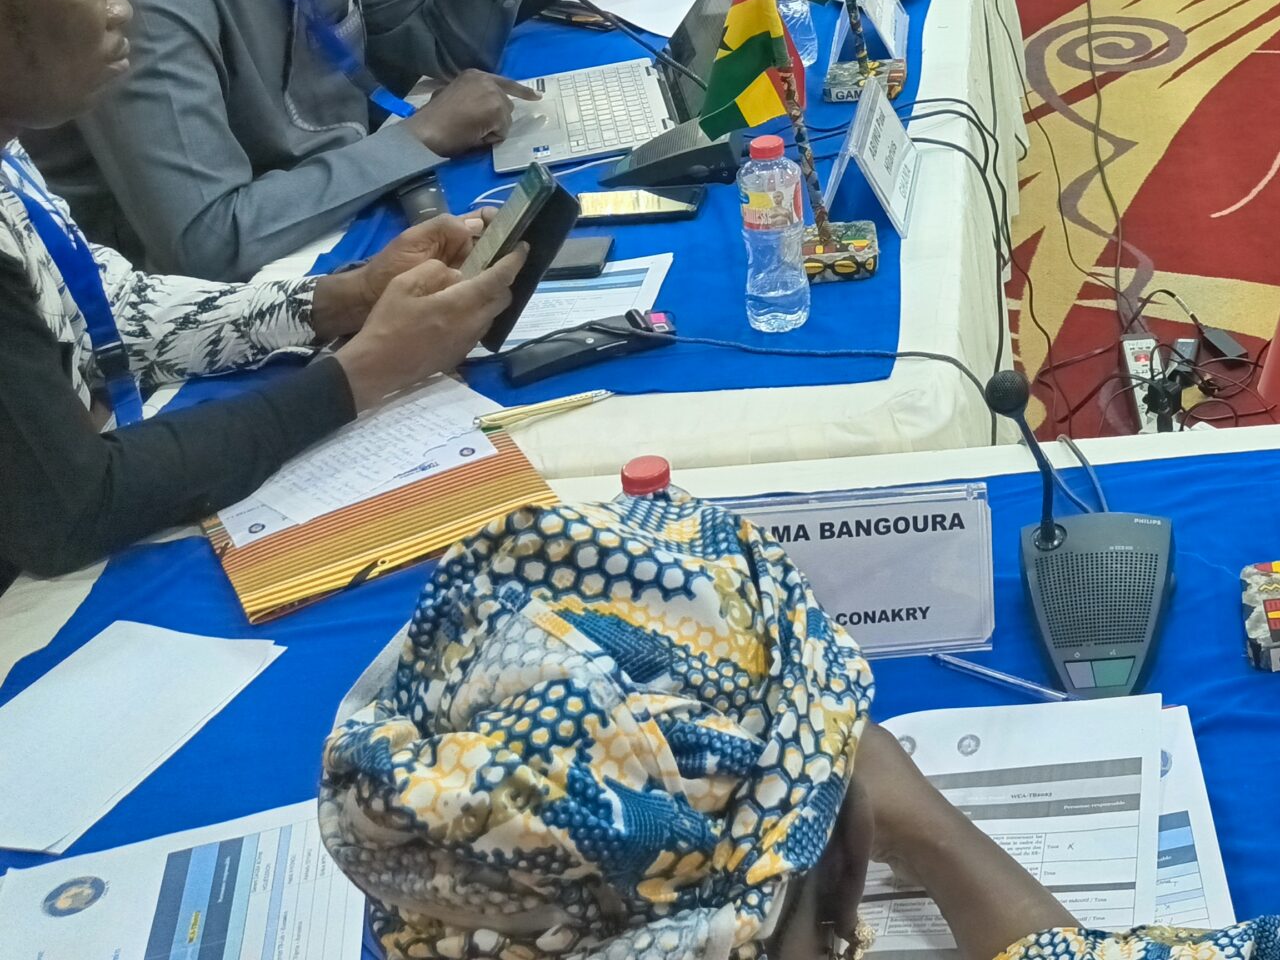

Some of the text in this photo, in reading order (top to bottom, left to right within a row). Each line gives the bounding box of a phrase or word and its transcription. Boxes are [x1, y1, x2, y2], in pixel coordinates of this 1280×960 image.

[771, 510, 966, 543] MA BANGOURA
[1133, 518, 1162, 526] PHILIPS
[835, 606, 931, 627] CONAKRY
